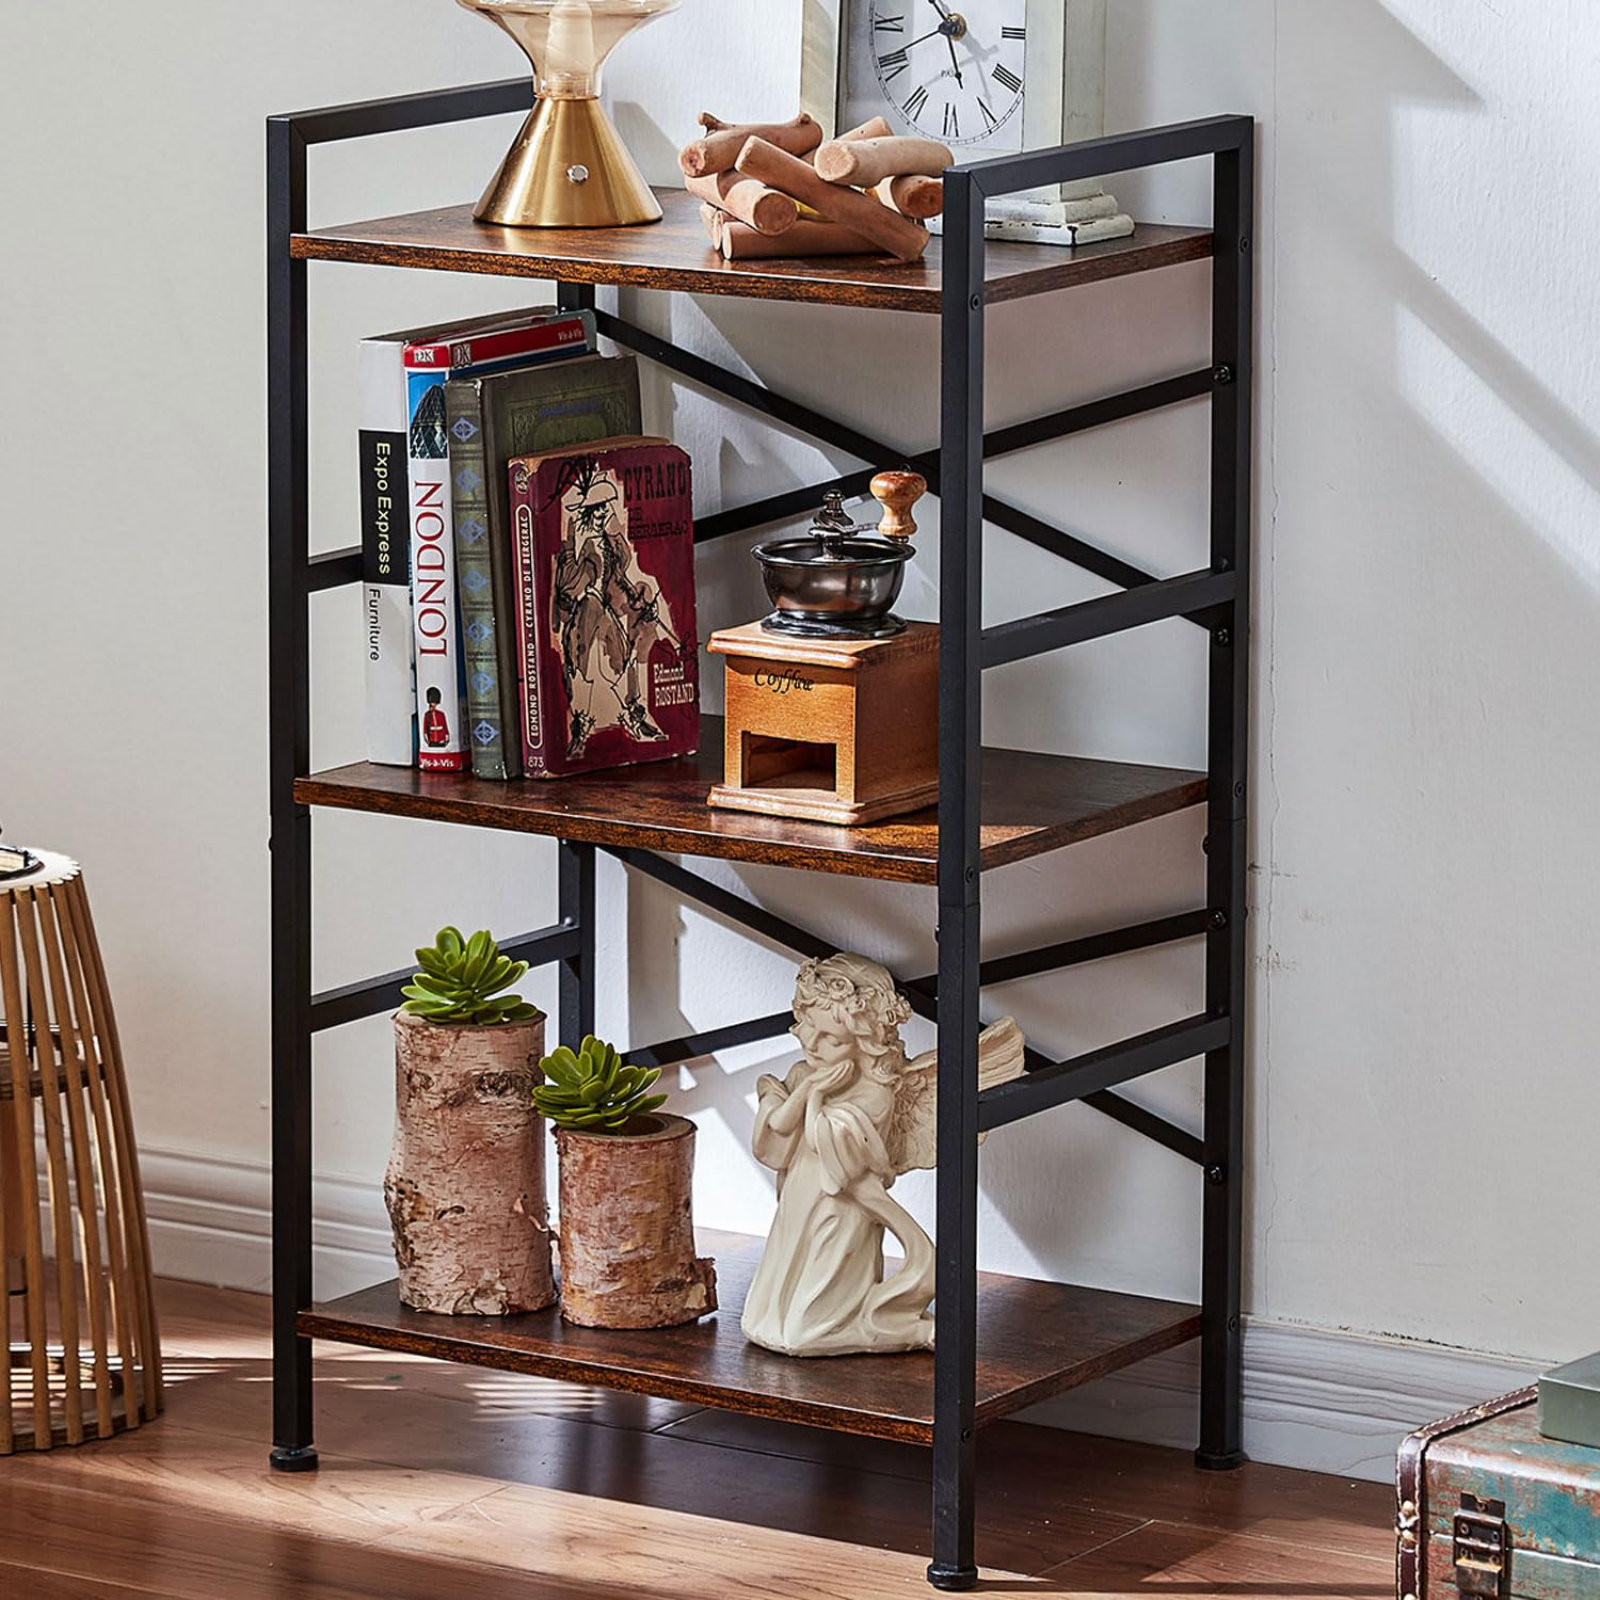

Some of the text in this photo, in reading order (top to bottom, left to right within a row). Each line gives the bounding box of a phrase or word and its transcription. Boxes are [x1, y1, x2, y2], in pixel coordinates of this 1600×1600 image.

[874, 13, 904, 33] IX
[1001, 26, 1026, 40] III
[878, 49, 910, 82] VIII
[991, 63, 1023, 94] IIII
[901, 85, 929, 122] VII
[943, 102, 959, 137] VI
[976, 96, 998, 135] V
[413, 349, 434, 363] DK
[453, 344, 472, 368] DK
[624, 461, 686, 501] CYRANO
[374, 442, 392, 574] Expo Express
[414, 480, 448, 657] LONDON
[369, 588, 381, 661] Furniture
[520, 516, 539, 737] EDMOND ROSTAND CYRANO DE BERGERAC
[653, 661, 684, 683] Edmond
[655, 683, 694, 707] ROSTAND
[528, 756, 545, 768] 873
